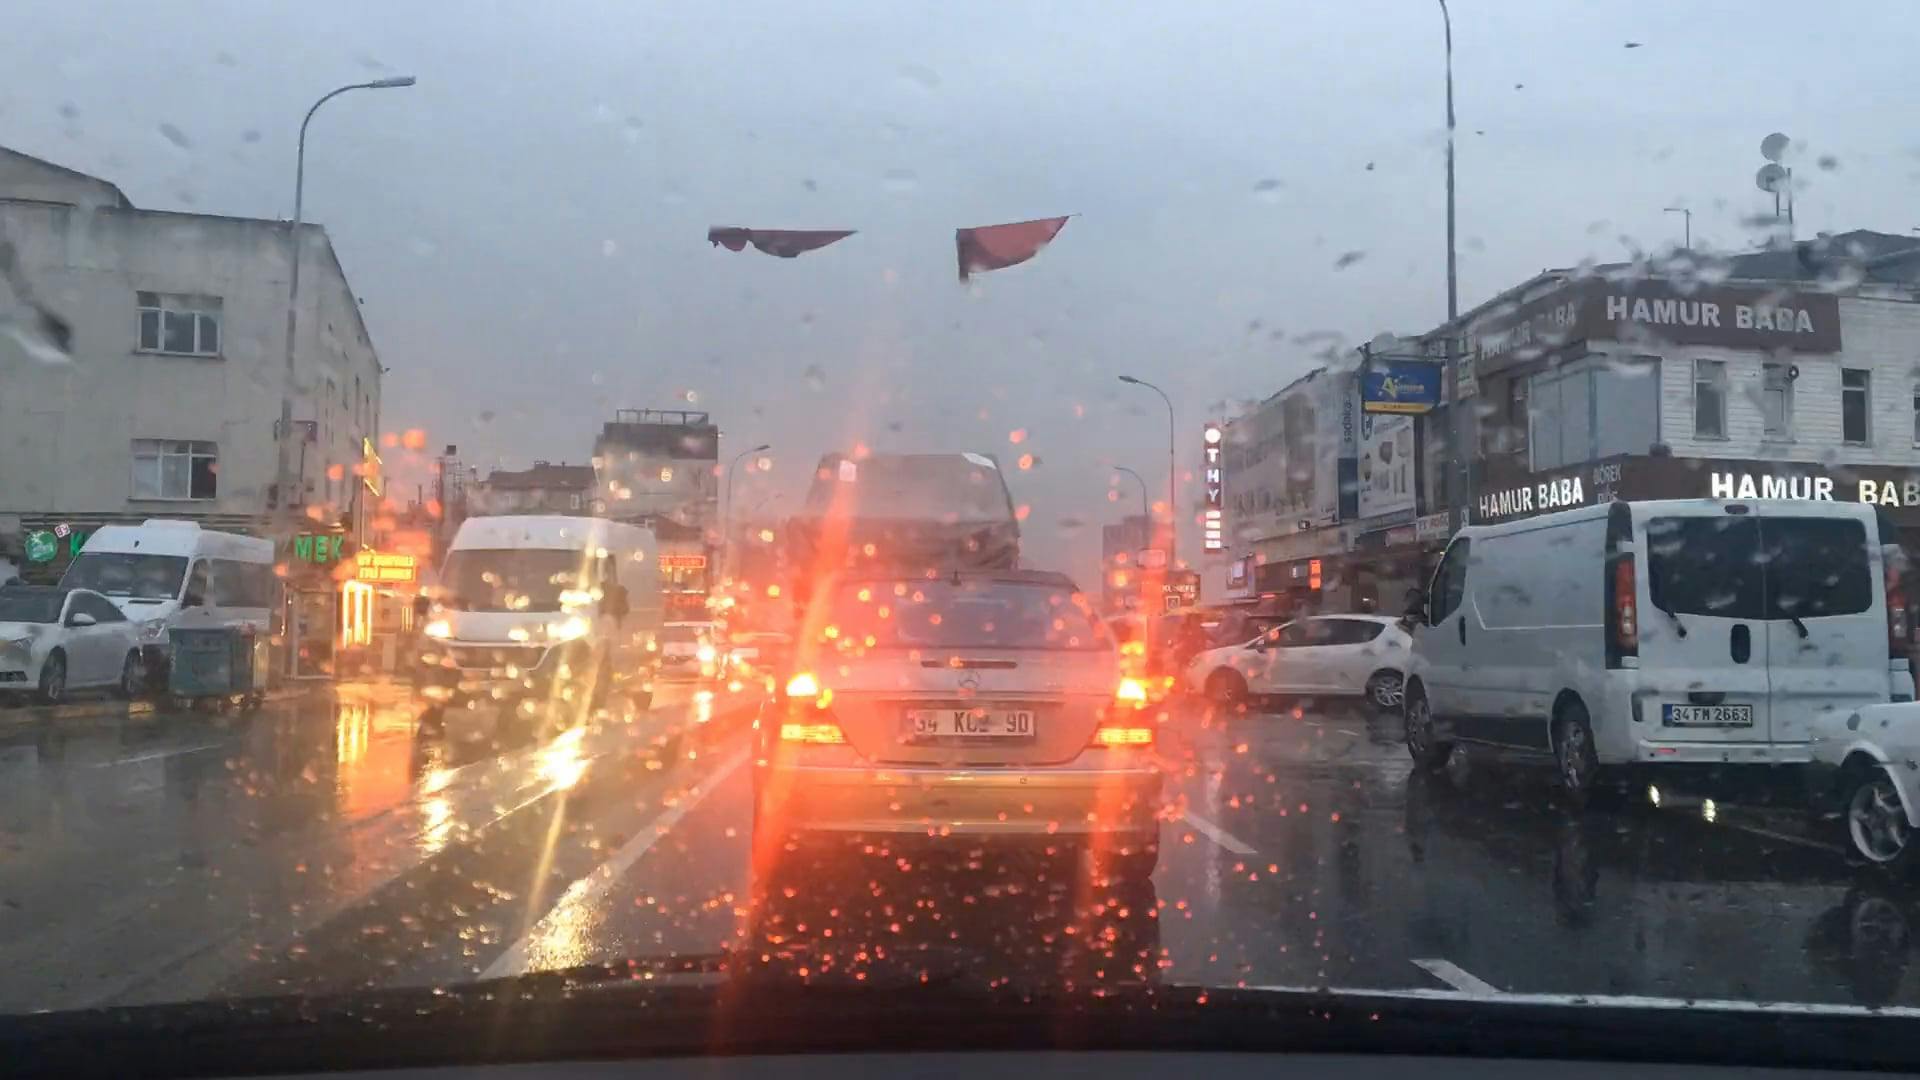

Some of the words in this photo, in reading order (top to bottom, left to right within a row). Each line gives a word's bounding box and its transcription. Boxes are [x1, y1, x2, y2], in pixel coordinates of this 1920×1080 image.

[1607, 295, 1721, 327] HAMUR
[1736, 304, 1815, 333] BABA
[1479, 486, 1534, 519] HAMUR
[1537, 476, 1584, 509] BABA
[1711, 472, 1834, 501] HAMUR
[1672, 707, 1690, 721] 34
